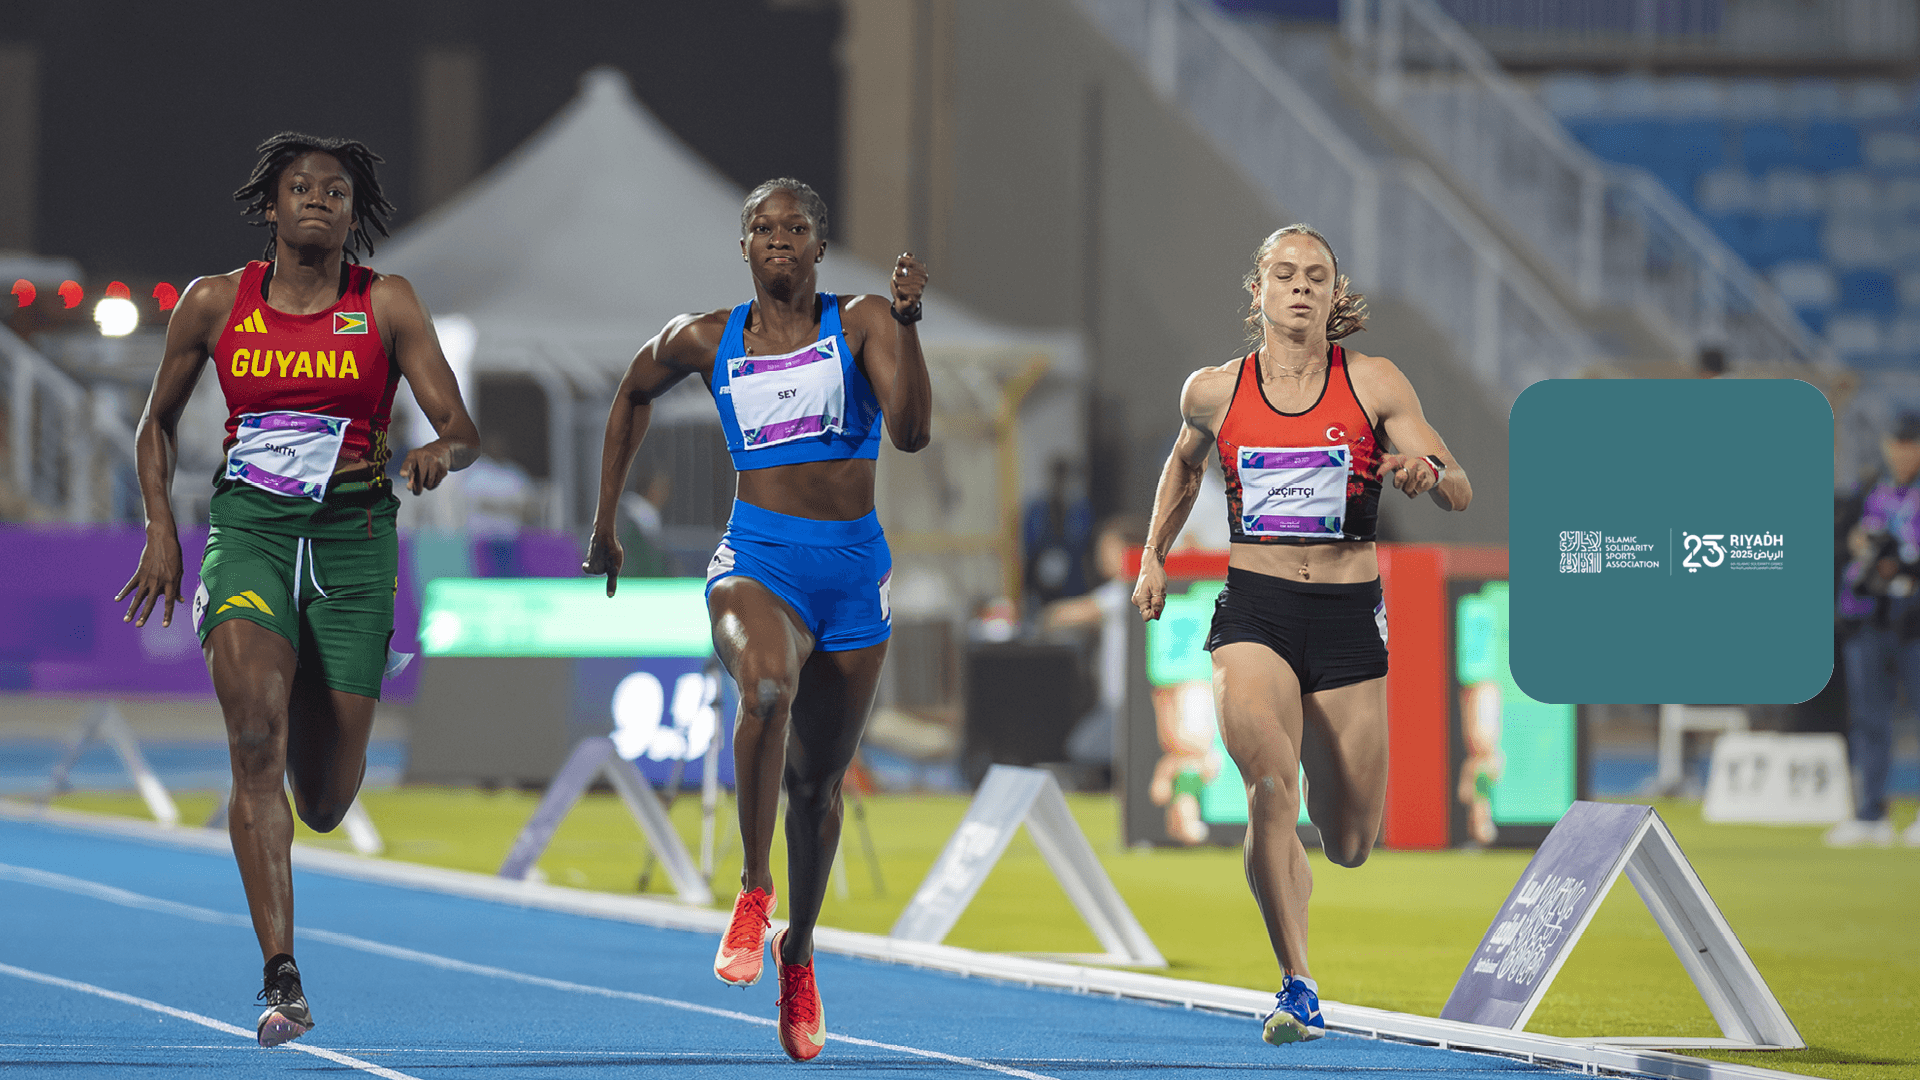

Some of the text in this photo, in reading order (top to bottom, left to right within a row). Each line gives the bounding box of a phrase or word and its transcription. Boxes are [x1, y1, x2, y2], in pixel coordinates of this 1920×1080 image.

[231, 348, 360, 380] GUYANA
[777, 388, 797, 400] SEY
[264, 442, 297, 458] SMITH
